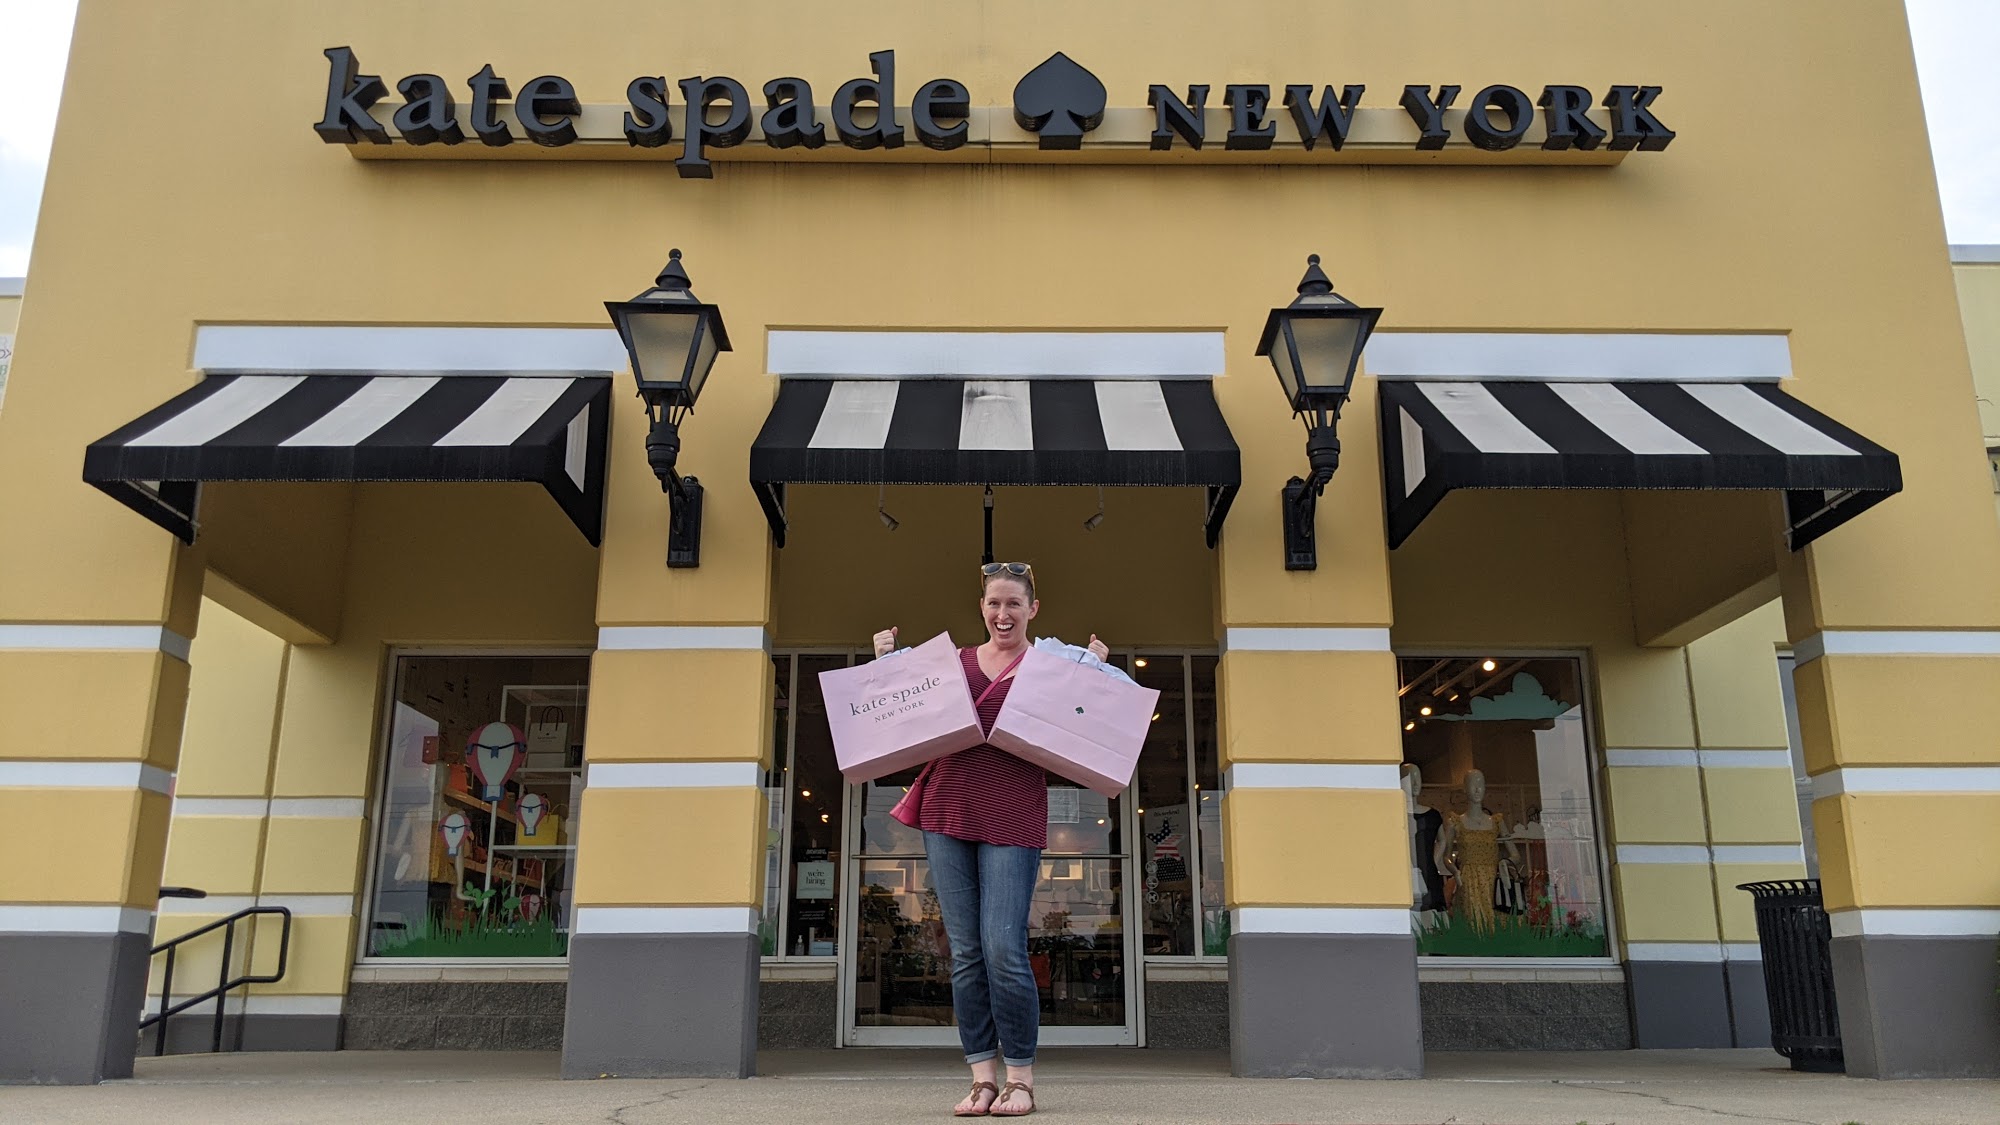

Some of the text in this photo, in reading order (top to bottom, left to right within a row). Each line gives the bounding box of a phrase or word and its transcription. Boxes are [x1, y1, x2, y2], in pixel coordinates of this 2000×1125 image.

[314, 46, 1675, 179] kate spade NEW YORK
[850, 677, 941, 716] kate spade
[874, 700, 925, 723] NEW YORK
[806, 876, 826, 886] hiring
